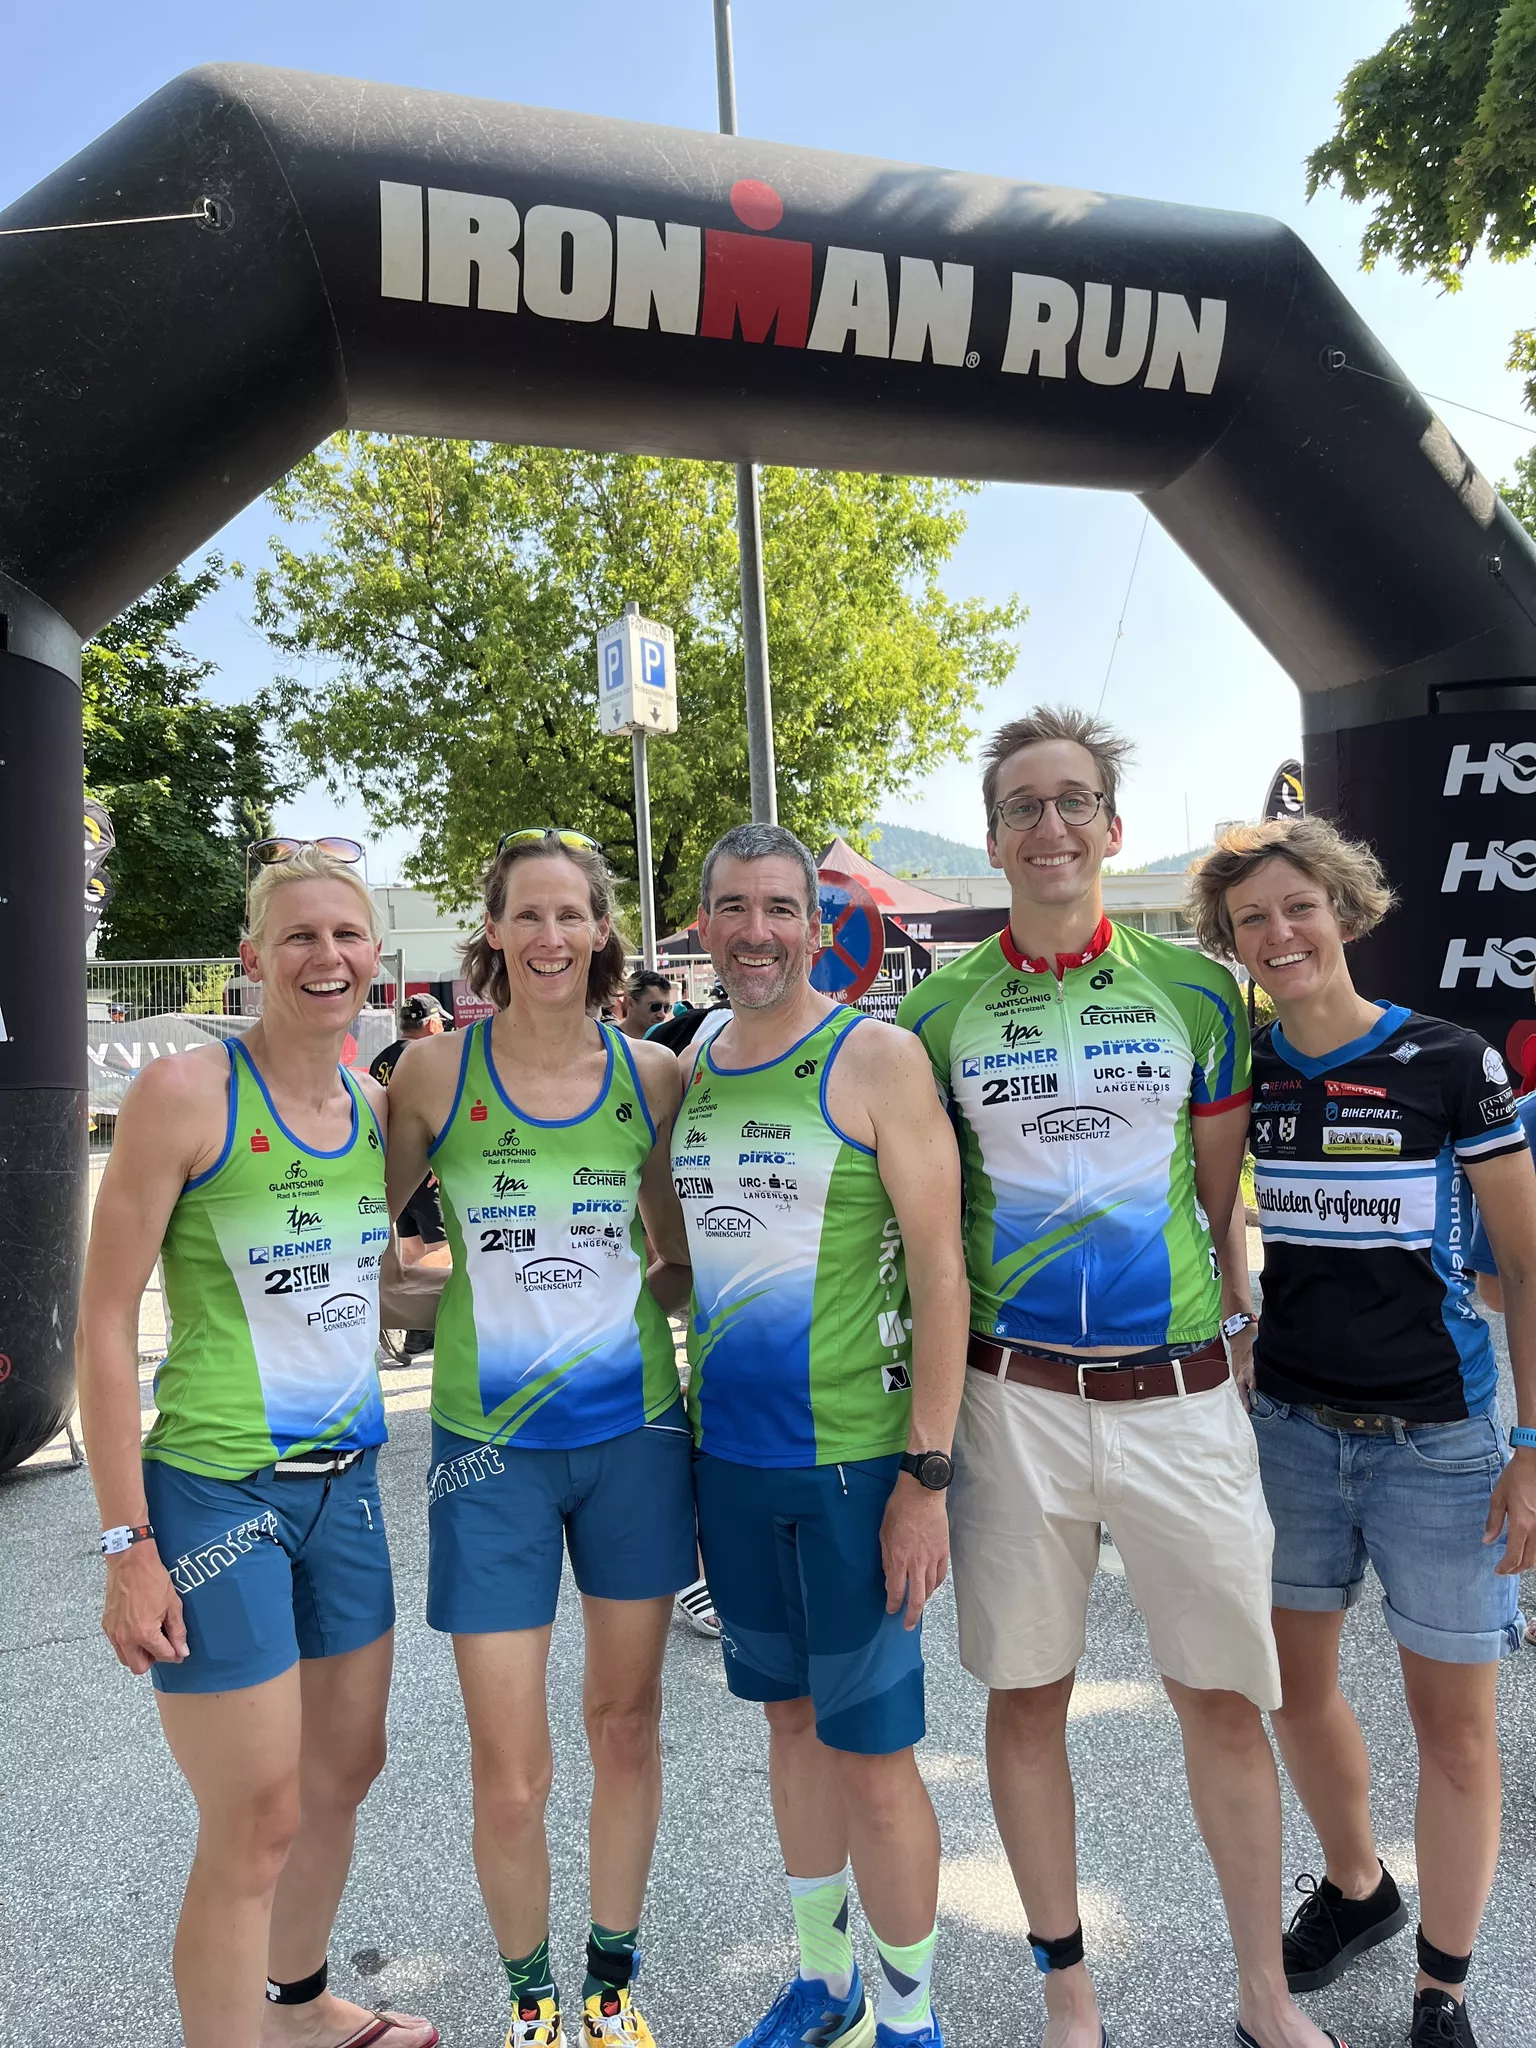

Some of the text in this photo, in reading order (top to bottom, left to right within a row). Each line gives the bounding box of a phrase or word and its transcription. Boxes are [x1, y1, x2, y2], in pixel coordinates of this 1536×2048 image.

[380, 179, 1228, 395] IRONMAN RUN
[607, 645, 619, 687] P
[645, 642, 661, 681] P
[858, 996, 904, 1006] TRANSITIO
[985, 993, 1051, 1011] GLANTSCHNIG
[871, 1009, 896, 1019] ZONE
[994, 1010, 1009, 1018] Rad
[1017, 1004, 1046, 1014] Freizeit
[1080, 1012, 1156, 1026] LECHNER
[1001, 1019, 1043, 1050] tpa
[984, 1047, 1058, 1070] RENNER
[1093, 1067, 1126, 1080] URC
[1096, 1083, 1170, 1094] LANGENLOIS
[1269, 1080, 1303, 1091] RE/MAX
[1021, 1116, 1110, 1137] PICKEM
[741, 1128, 790, 1139] LECHNER
[1040, 1131, 1110, 1144] SONNENSCHUTZ
[482, 1148, 537, 1158] GLANTSCHNIG
[675, 1155, 711, 1167] RENNER
[269, 1179, 324, 1192] GLANTSCHNIG
[492, 1170, 529, 1200] tpa
[573, 1175, 626, 1186] LECHNER
[739, 1177, 761, 1188] URC
[743, 1191, 799, 1201] LANGENLOIS
[358, 1204, 388, 1215] LECHNE
[481, 1204, 537, 1219] RENNER
[1314, 1188, 1401, 1225] Grafenegg
[286, 1204, 323, 1236] tpa
[361, 1227, 391, 1245] pirk
[570, 1225, 596, 1236] URC
[705, 1230, 751, 1238] SONNENSCHUTZ
[273, 1238, 332, 1258] RENNER
[524, 1281, 582, 1292] SONNENSCHUTZ
[323, 1317, 366, 1333] SONNENSCHUTZ
[169, 1510, 278, 1594] kinfit
